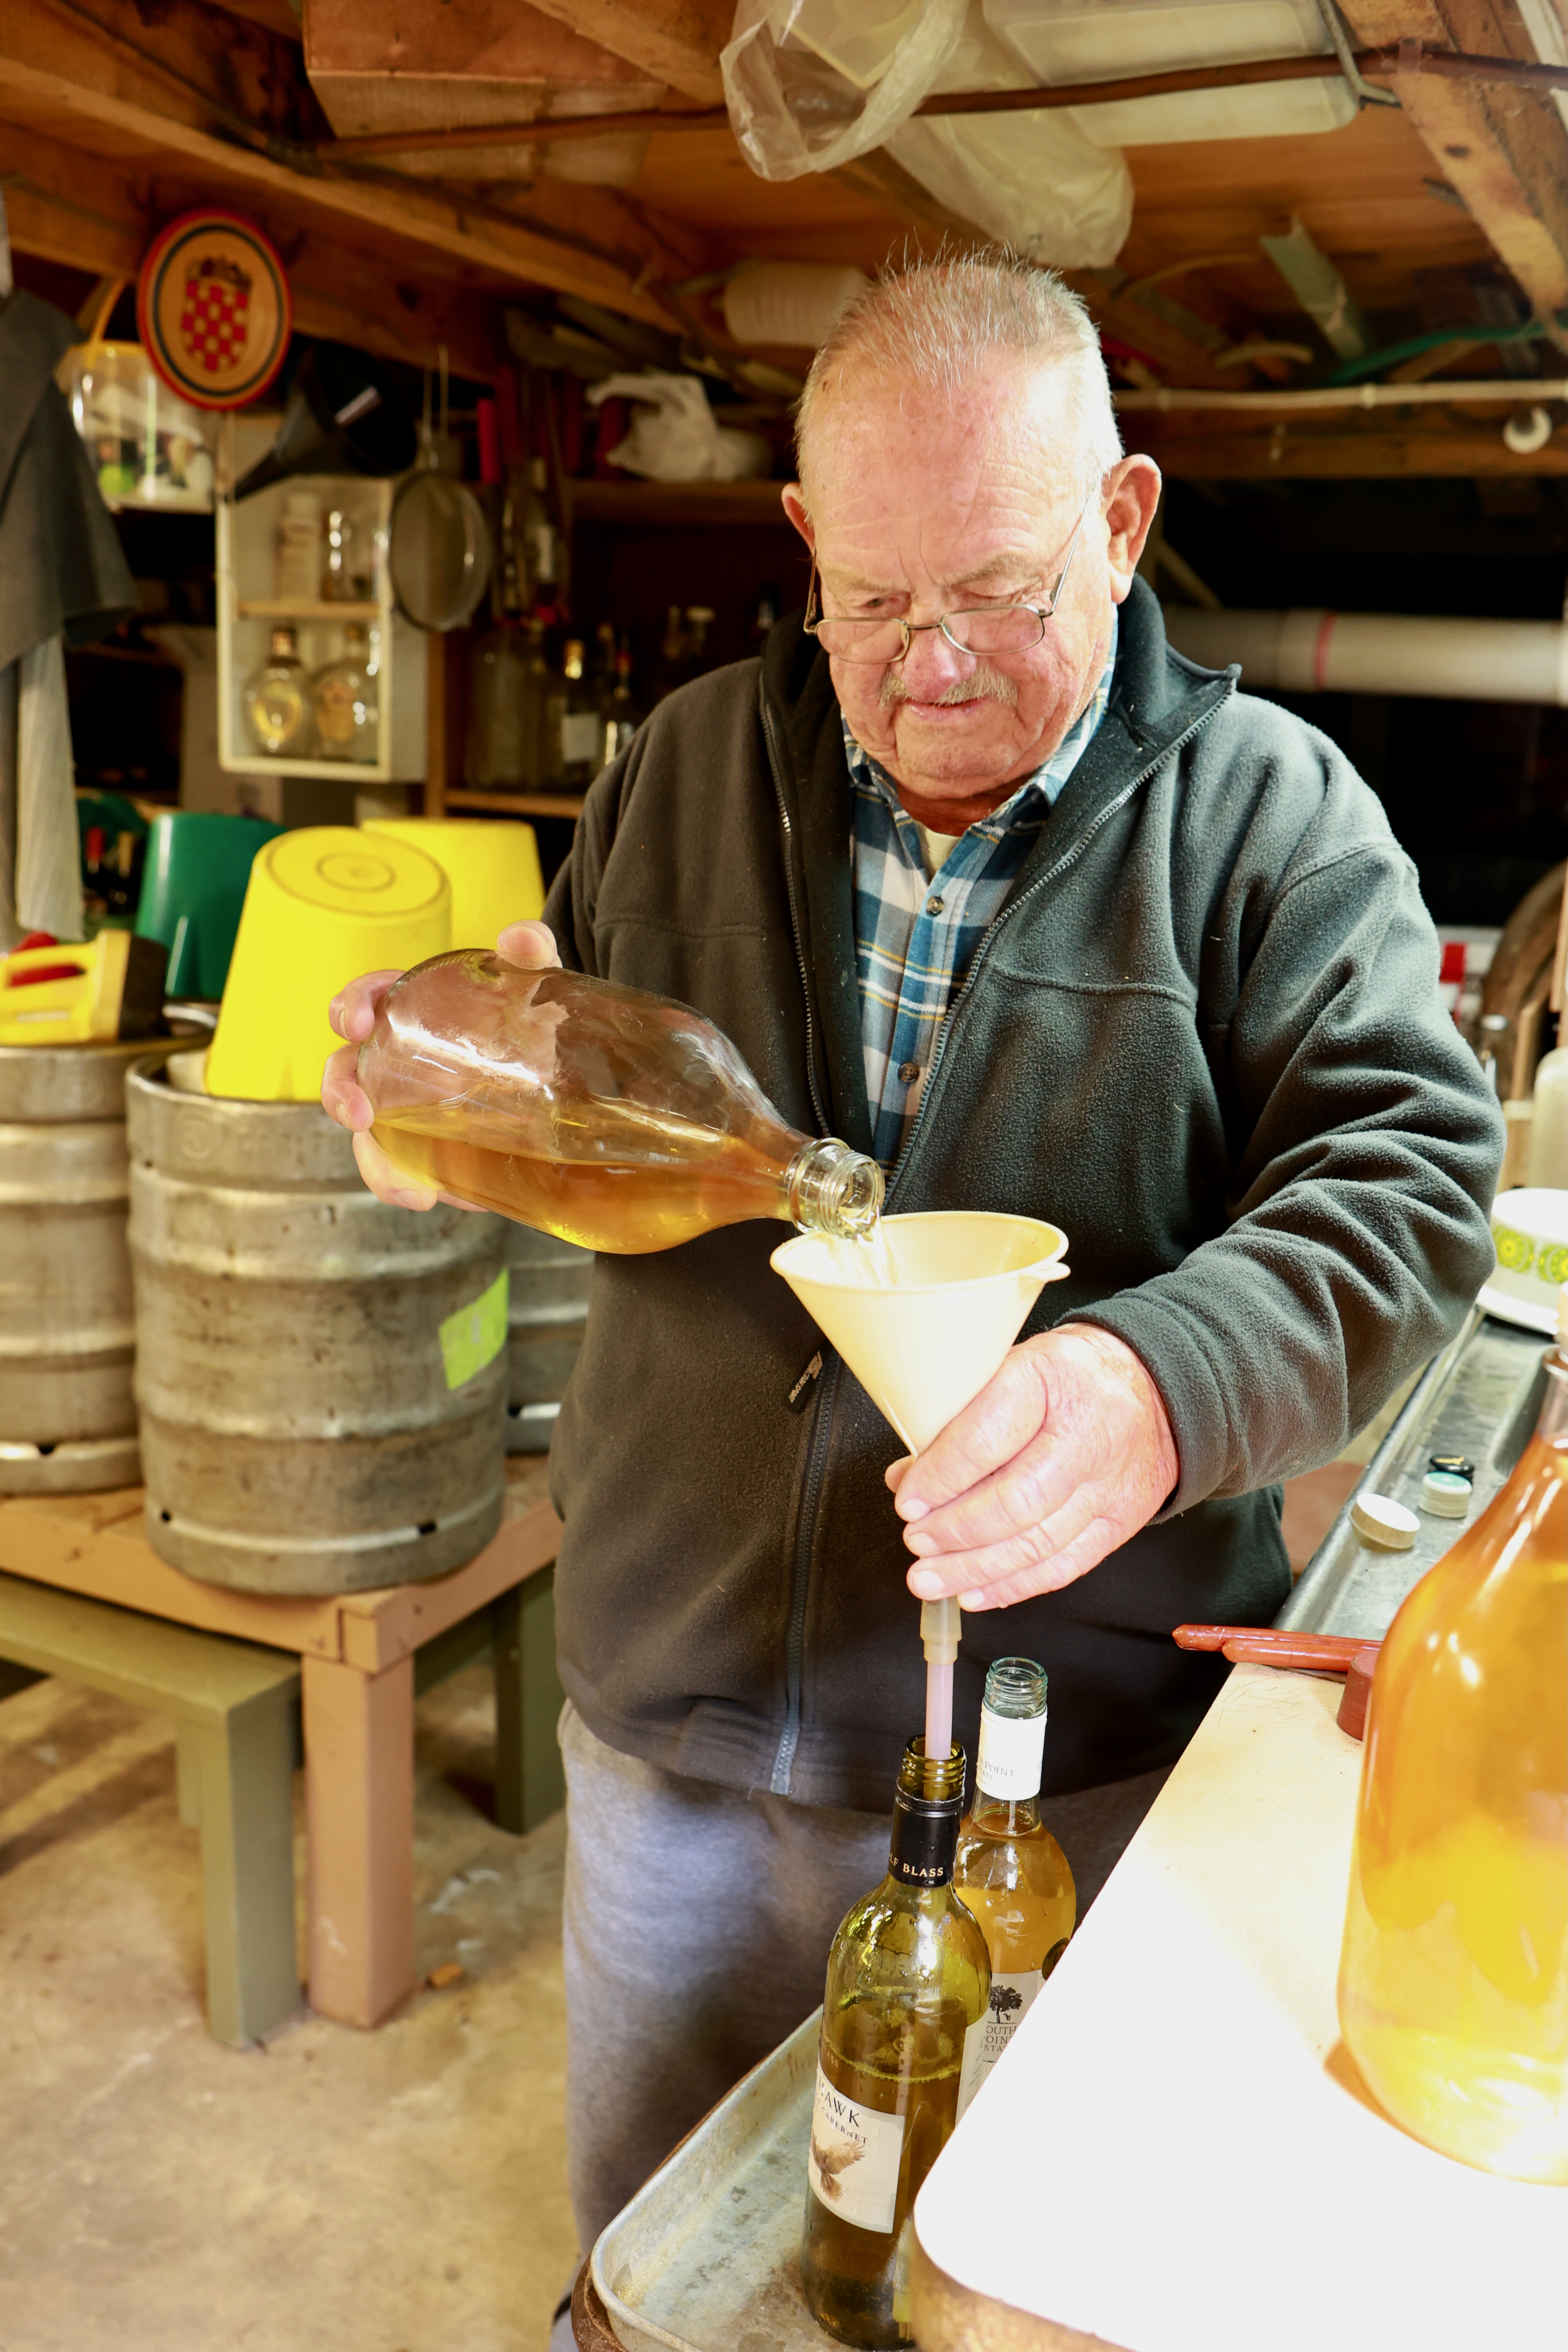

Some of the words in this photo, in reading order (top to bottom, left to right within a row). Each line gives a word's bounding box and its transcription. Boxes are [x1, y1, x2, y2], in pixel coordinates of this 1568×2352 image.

[977, 1765, 994, 1781] STATE
[985, 1761, 1016, 1777] POINT
[890, 1853, 899, 1866] LF
[903, 1863, 944, 1878] BLASS
[986, 2025, 1017, 2035] OUTH
[986, 2035, 1012, 2044] OIN
[818, 2076, 860, 2128] HAWK
[822, 2106, 868, 2144] CABERNET
